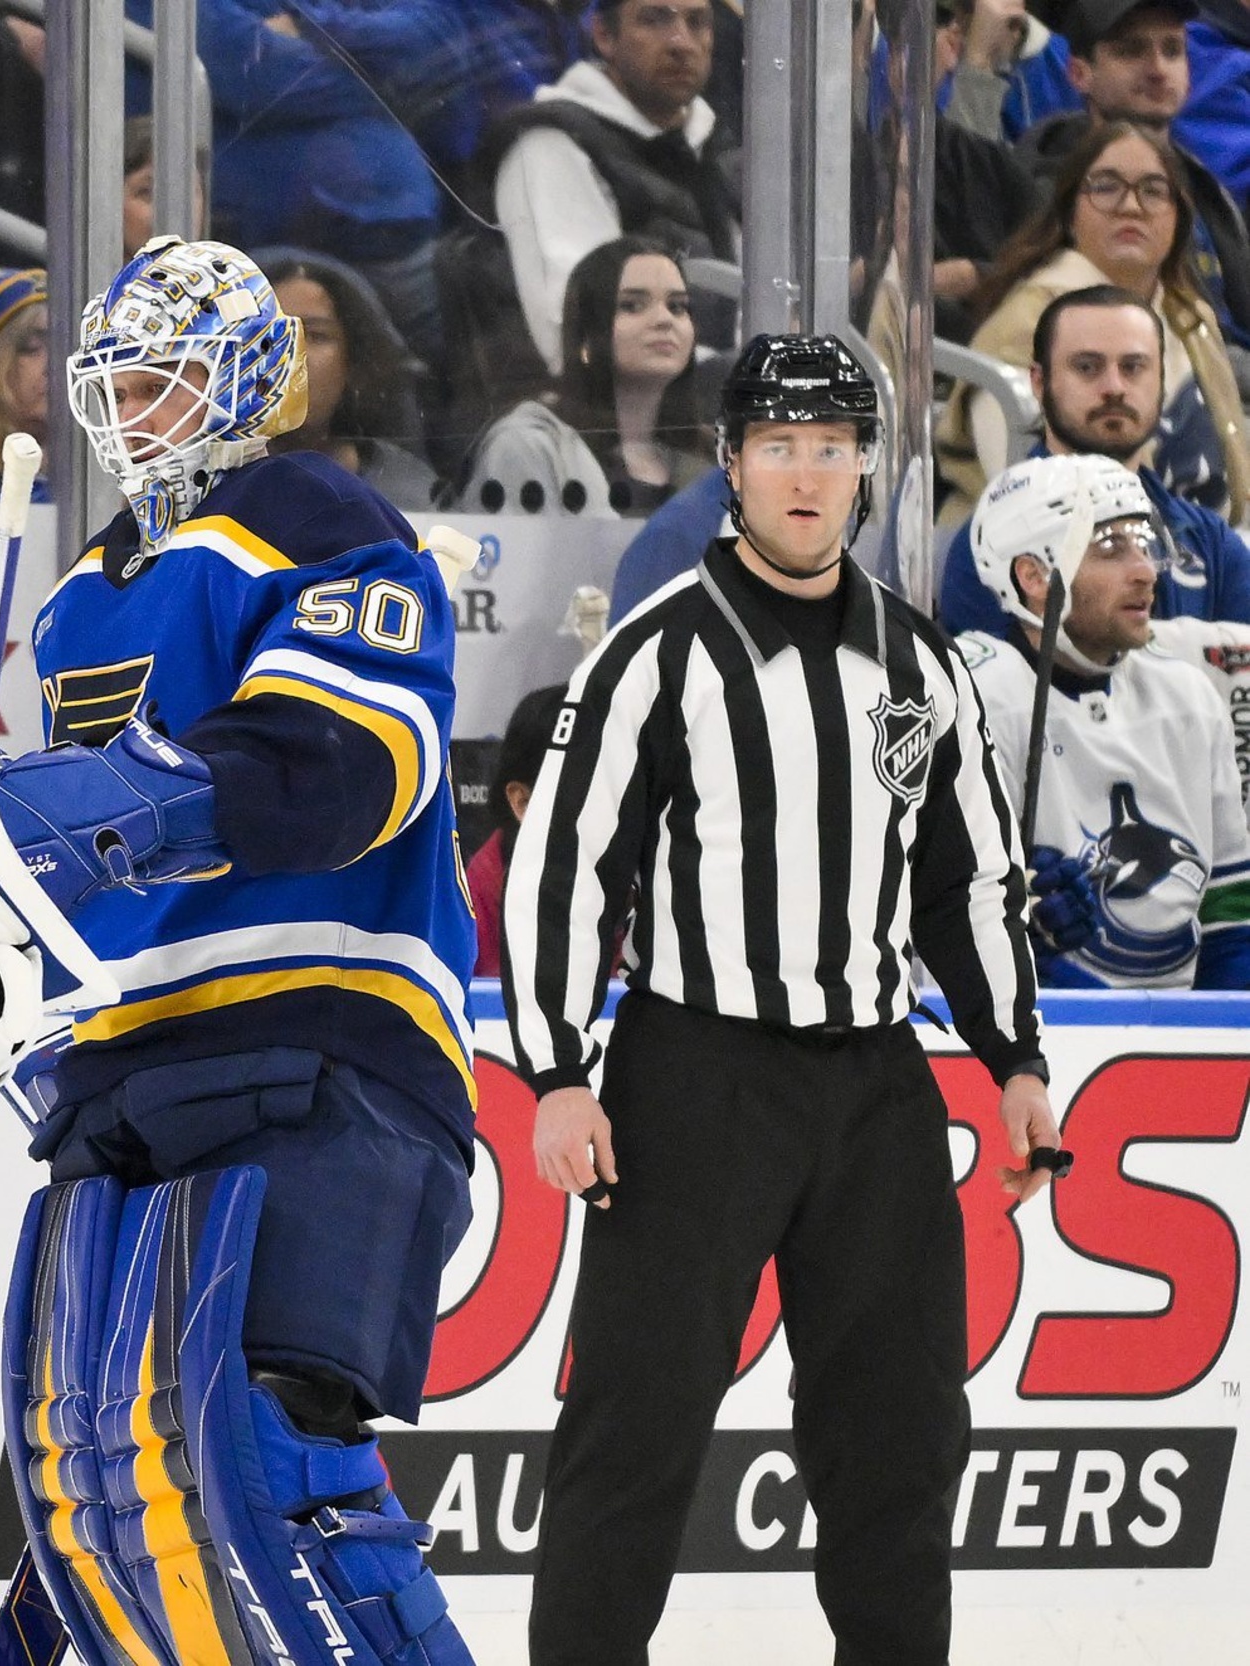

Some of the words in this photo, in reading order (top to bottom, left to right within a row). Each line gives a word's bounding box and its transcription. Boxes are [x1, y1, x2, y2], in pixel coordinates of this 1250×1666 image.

[292, 578, 424, 656] 50
[552, 708, 577, 745] 8
[891, 725, 930, 778] NHL
[735, 1449, 1190, 1551] CTERS
